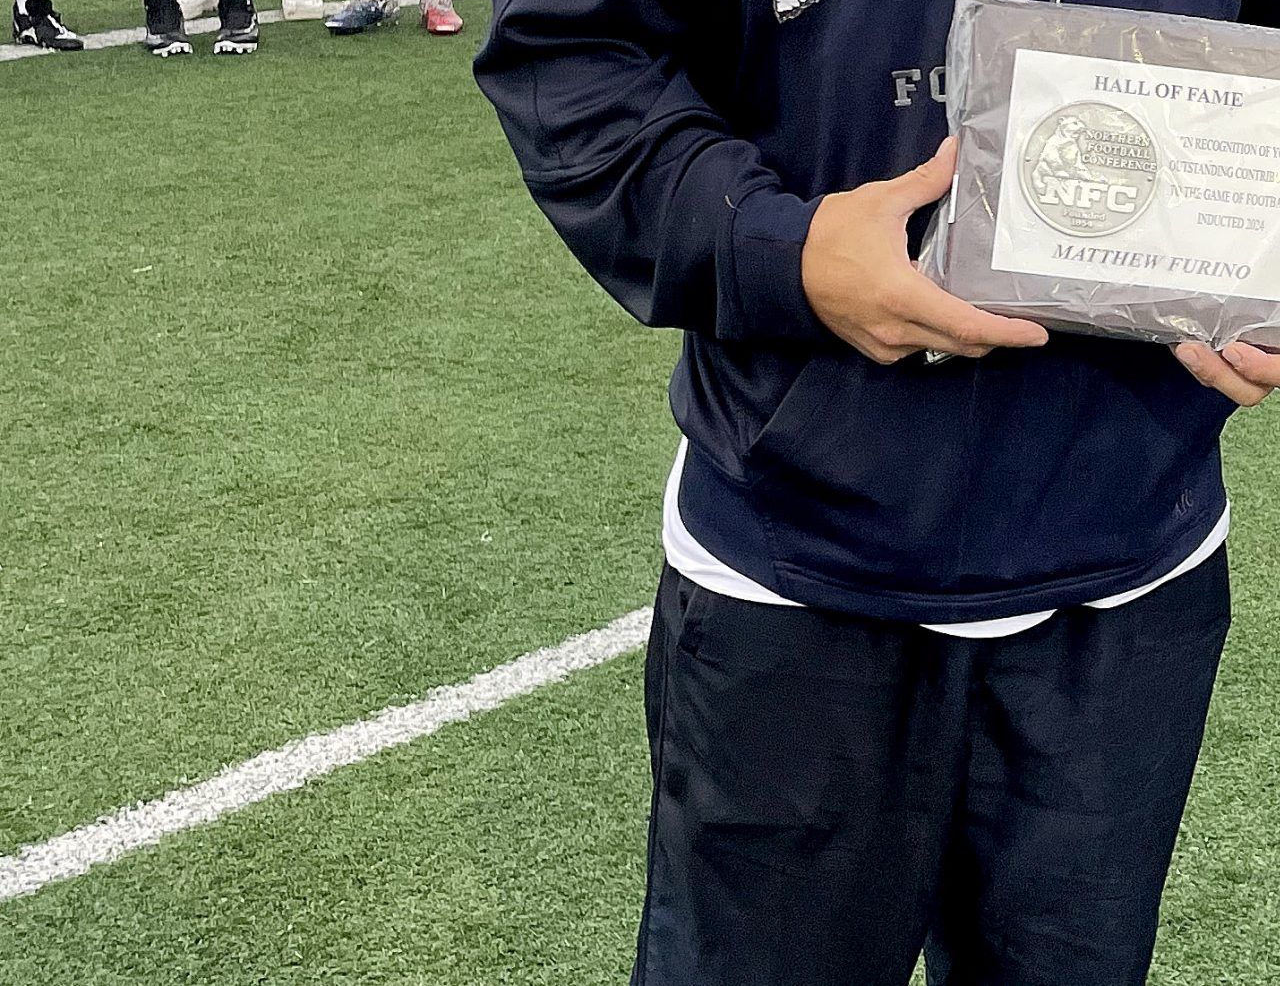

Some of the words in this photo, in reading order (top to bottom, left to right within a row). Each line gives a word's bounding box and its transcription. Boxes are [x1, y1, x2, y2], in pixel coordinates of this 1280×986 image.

[1095, 75, 1150, 96] HALL
[1155, 83, 1183, 100] OF
[1187, 86, 1243, 107] FAME
[1085, 129, 1150, 147] NORTHERN
[1087, 142, 1150, 159] FOOTBALL
[1195, 138, 1257, 156] RECOGNITION
[1259, 145, 1271, 158] OF
[1082, 154, 1157, 172] CONFERENCE
[1169, 160, 1233, 178] OUTSTANDING
[1039, 176, 1138, 213] NFC
[1184, 186, 1201, 199] THE
[1204, 189, 1230, 203] GAME
[1232, 192, 1244, 204] OF
[1197, 213, 1244, 229] INDUCTED
[1051, 244, 1164, 269] MATTHEW
[1168, 257, 1251, 280] FURINO
